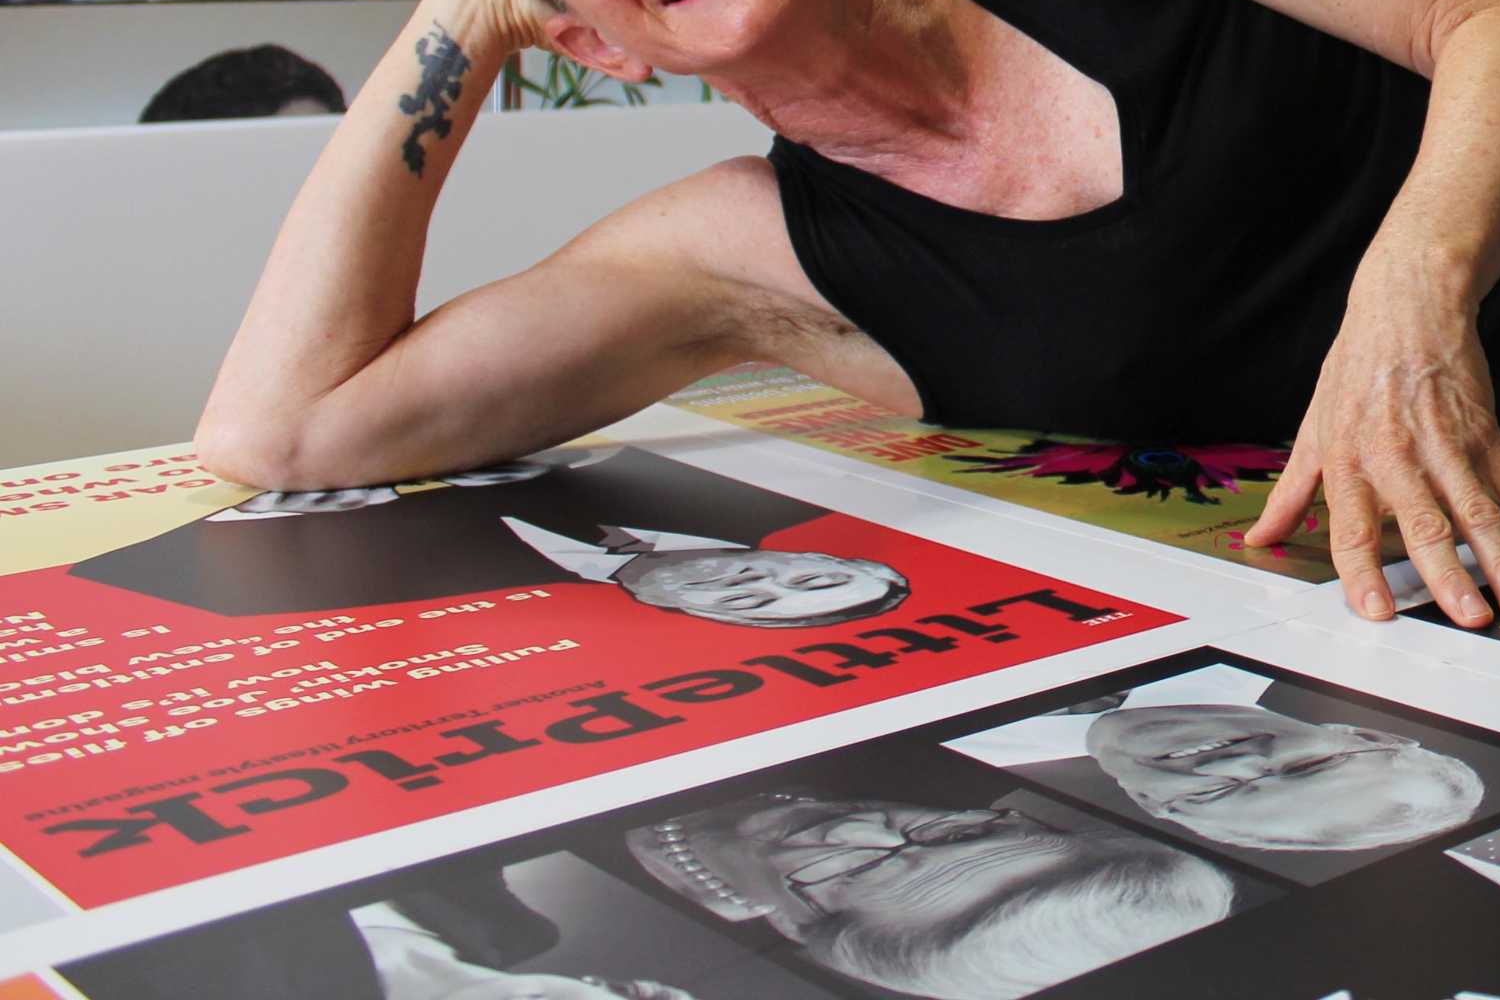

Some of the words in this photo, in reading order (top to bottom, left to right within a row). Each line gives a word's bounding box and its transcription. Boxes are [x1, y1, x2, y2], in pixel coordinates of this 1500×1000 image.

[804, 426, 909, 450] THE
[852, 433, 984, 463] DAVE
[505, 589, 552, 602] Is
[417, 600, 497, 620] the
[1081, 609, 1134, 627] THE
[55, 627, 89, 638] a
[120, 624, 172, 639] Is
[273, 615, 357, 635] the
[313, 618, 405, 642] end
[0, 637, 105, 664] smi
[252, 639, 301, 657] of
[406, 638, 581, 681] Pulling
[0, 652, 236, 707] entitlem
[227, 660, 339, 689] how
[167, 689, 269, 717] Joe
[234, 678, 399, 719] wings
[495, 680, 606, 712] Another
[143, 717, 219, 743] off
[344, 708, 489, 751] Territory
[207, 742, 344, 778] lifestyle
[23, 774, 200, 823] magazine
